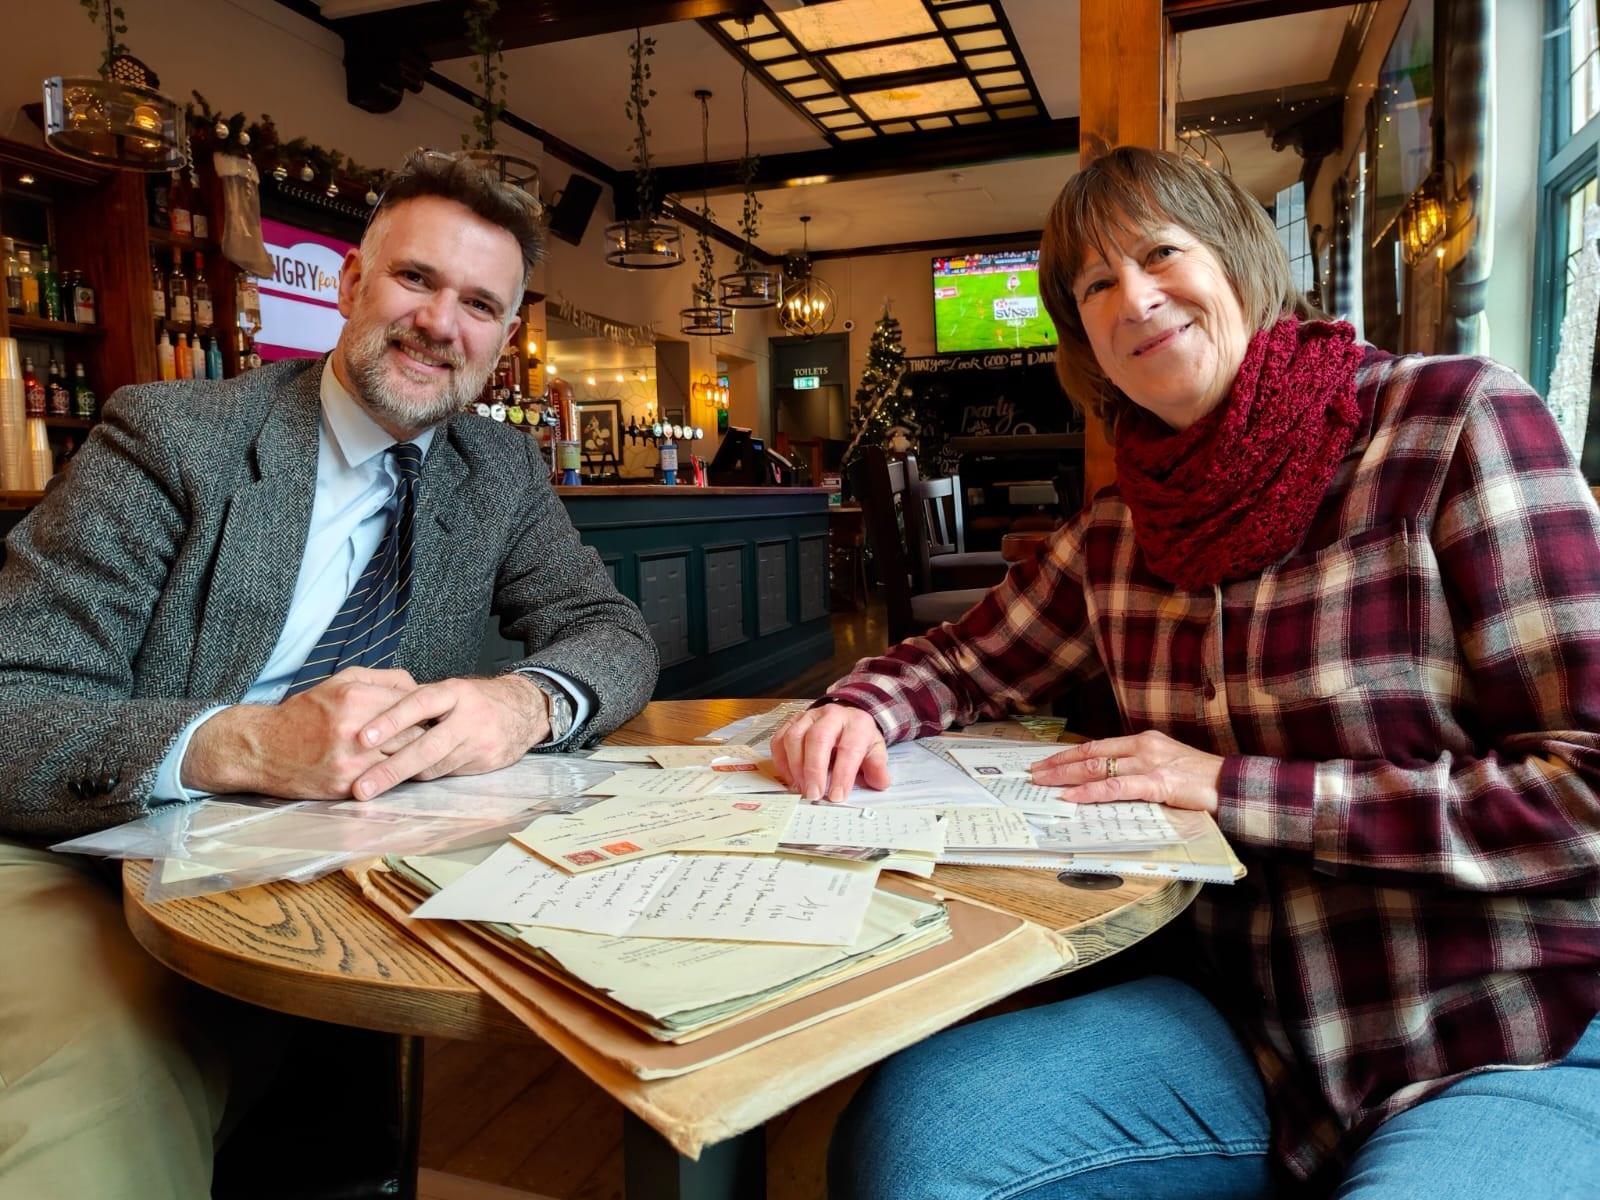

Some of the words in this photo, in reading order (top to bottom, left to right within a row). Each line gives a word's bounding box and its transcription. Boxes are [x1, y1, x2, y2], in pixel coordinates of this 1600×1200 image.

[318, 271, 337, 292] for
[793, 366, 829, 376] TOILETS
[910, 359, 930, 373] THAT
[983, 354, 1009, 370] GOOD
[961, 395, 1017, 434] party
